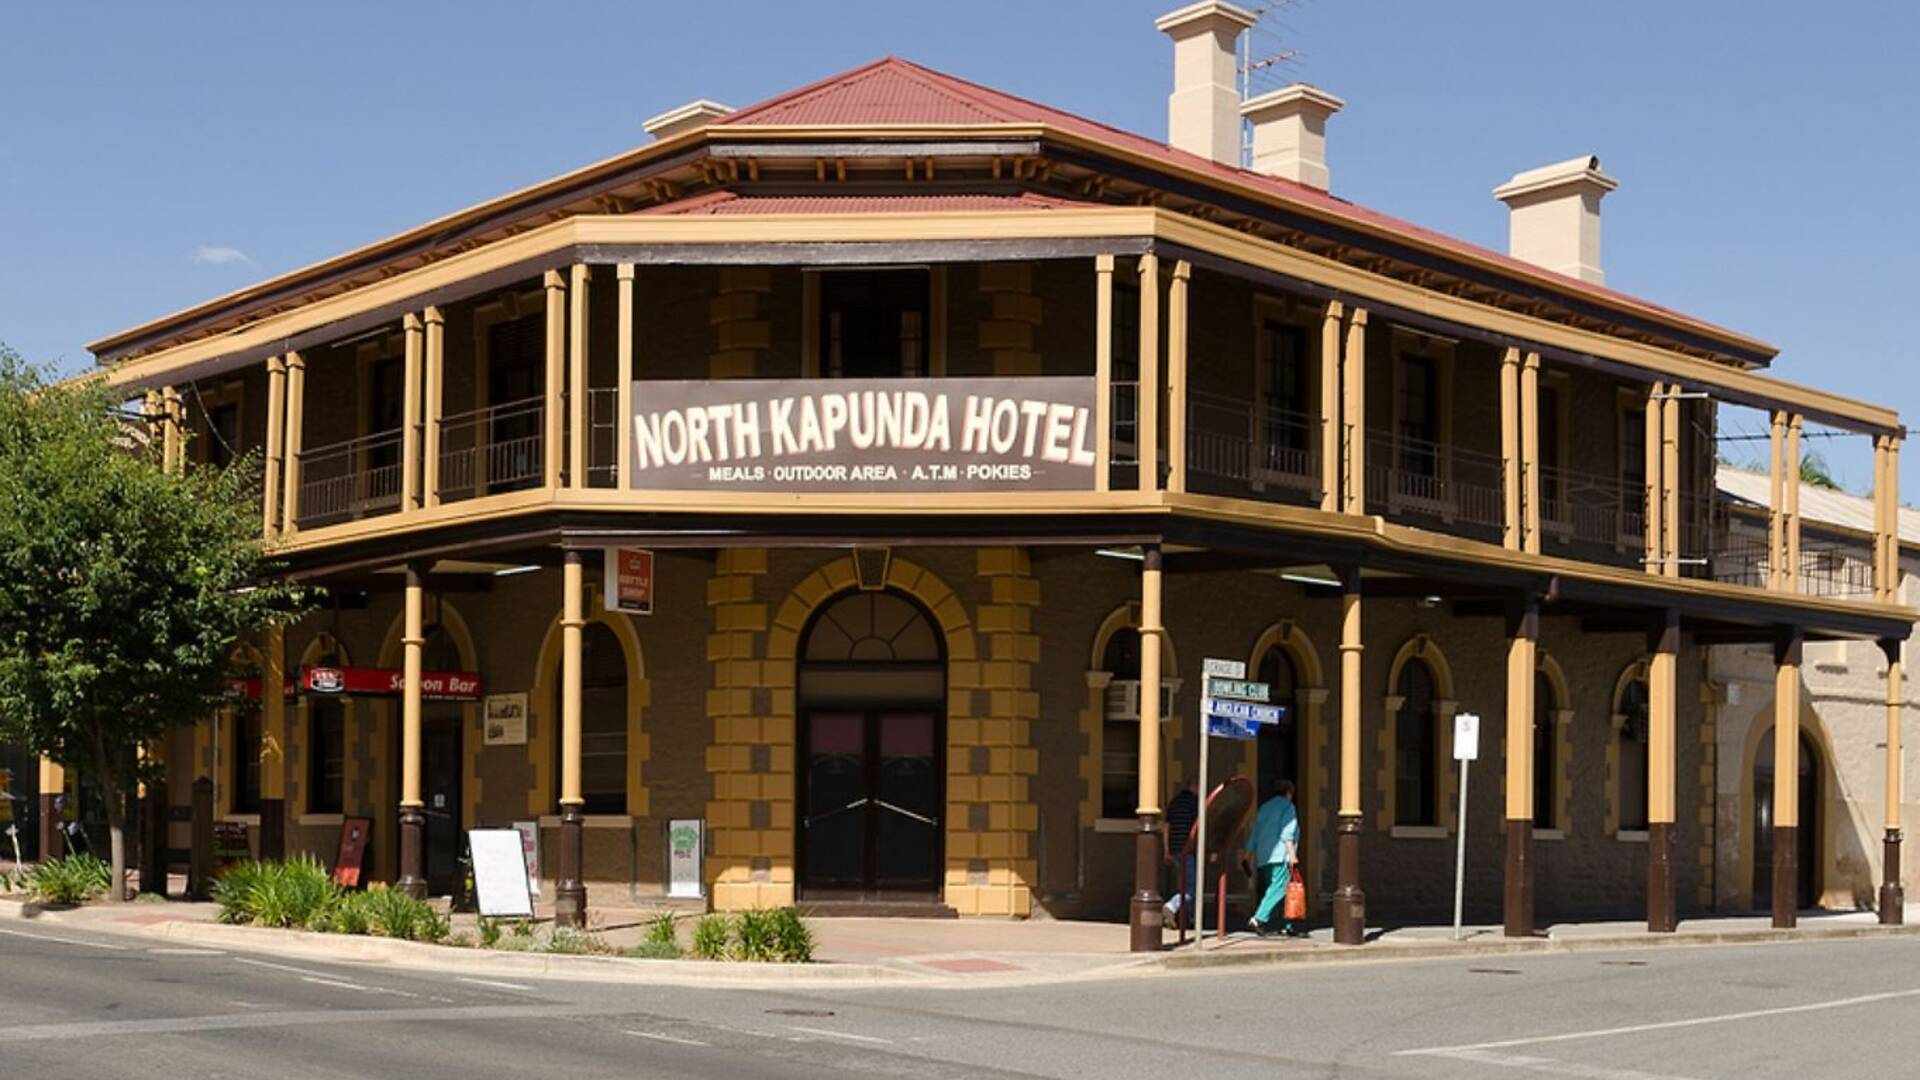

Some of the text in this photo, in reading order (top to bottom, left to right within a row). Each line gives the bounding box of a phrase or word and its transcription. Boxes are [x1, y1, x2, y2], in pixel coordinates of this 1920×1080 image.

[634, 391, 1096, 470] NORTH KAPUNDA HOTEL
[709, 464, 1032, 481] MEALS OUTDOOR AREA A.T.M POKIES
[390, 675, 477, 692] Saon Bar
